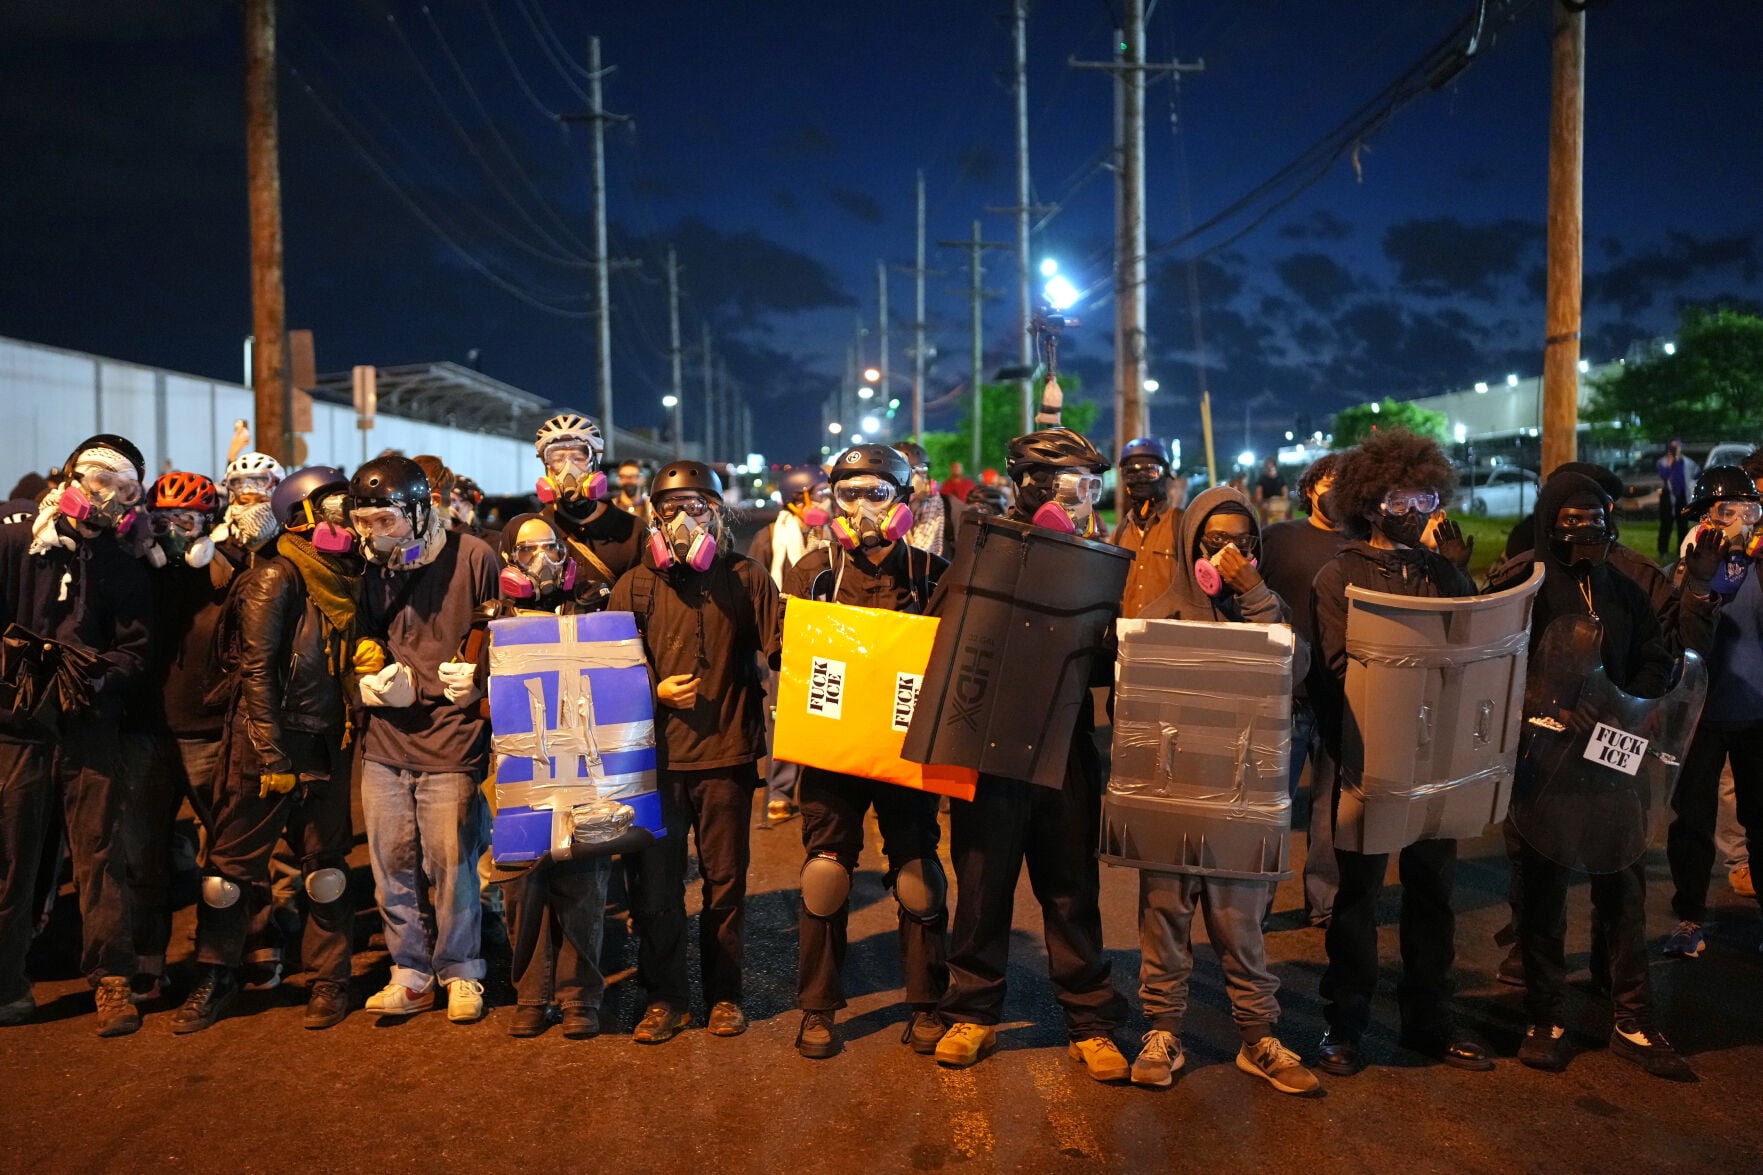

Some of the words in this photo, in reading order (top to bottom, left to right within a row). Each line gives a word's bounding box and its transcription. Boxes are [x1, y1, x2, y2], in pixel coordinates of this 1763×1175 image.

[810, 660, 828, 712] FUCK
[825, 673, 842, 706] ICE
[894, 676, 914, 728] FUCK
[947, 645, 994, 733] HDX
[1596, 726, 1645, 756] FUCK
[1599, 745, 1630, 769] ICE
